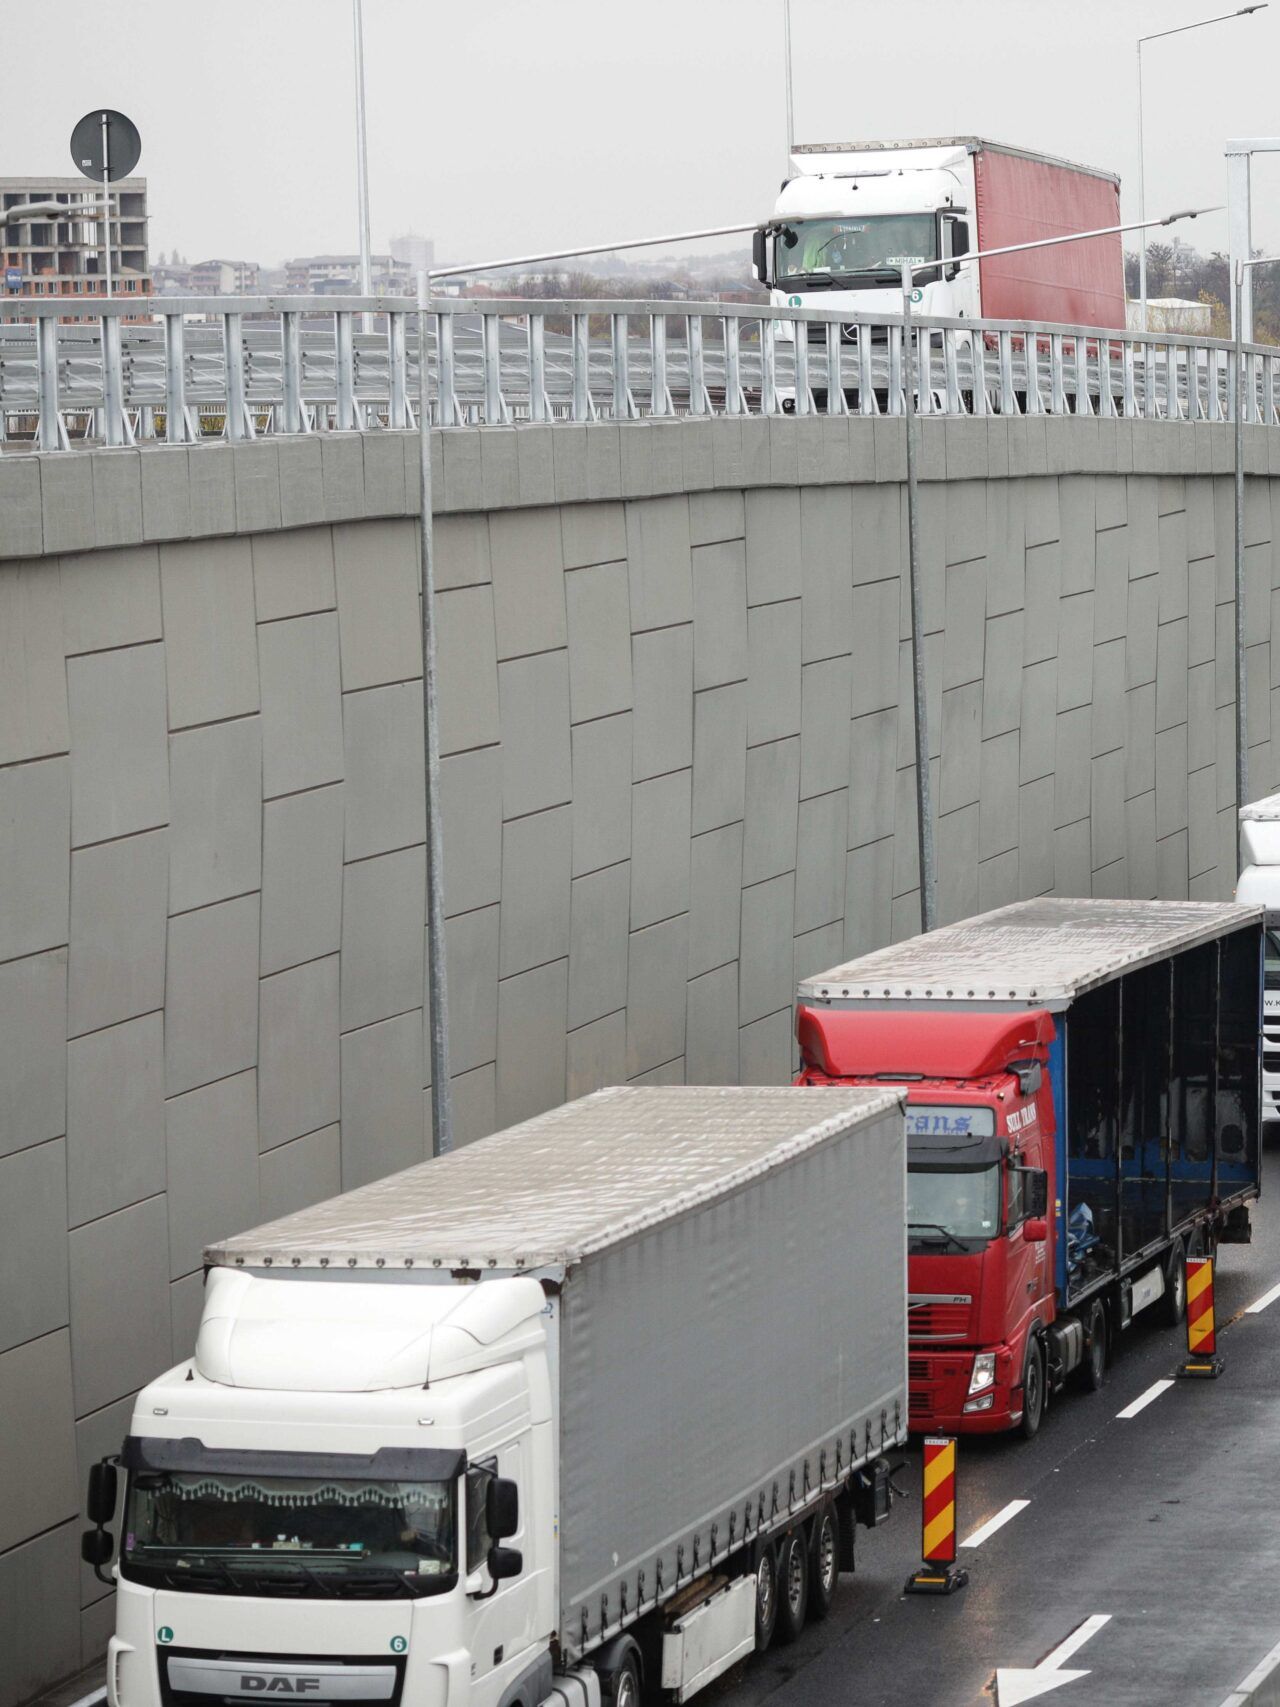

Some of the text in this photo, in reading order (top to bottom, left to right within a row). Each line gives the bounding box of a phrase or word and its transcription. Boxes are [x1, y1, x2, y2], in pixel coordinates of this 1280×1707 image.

[161, 1628, 169, 1641] L
[393, 1638, 404, 1650] 6
[240, 1675, 320, 1693] DAF
